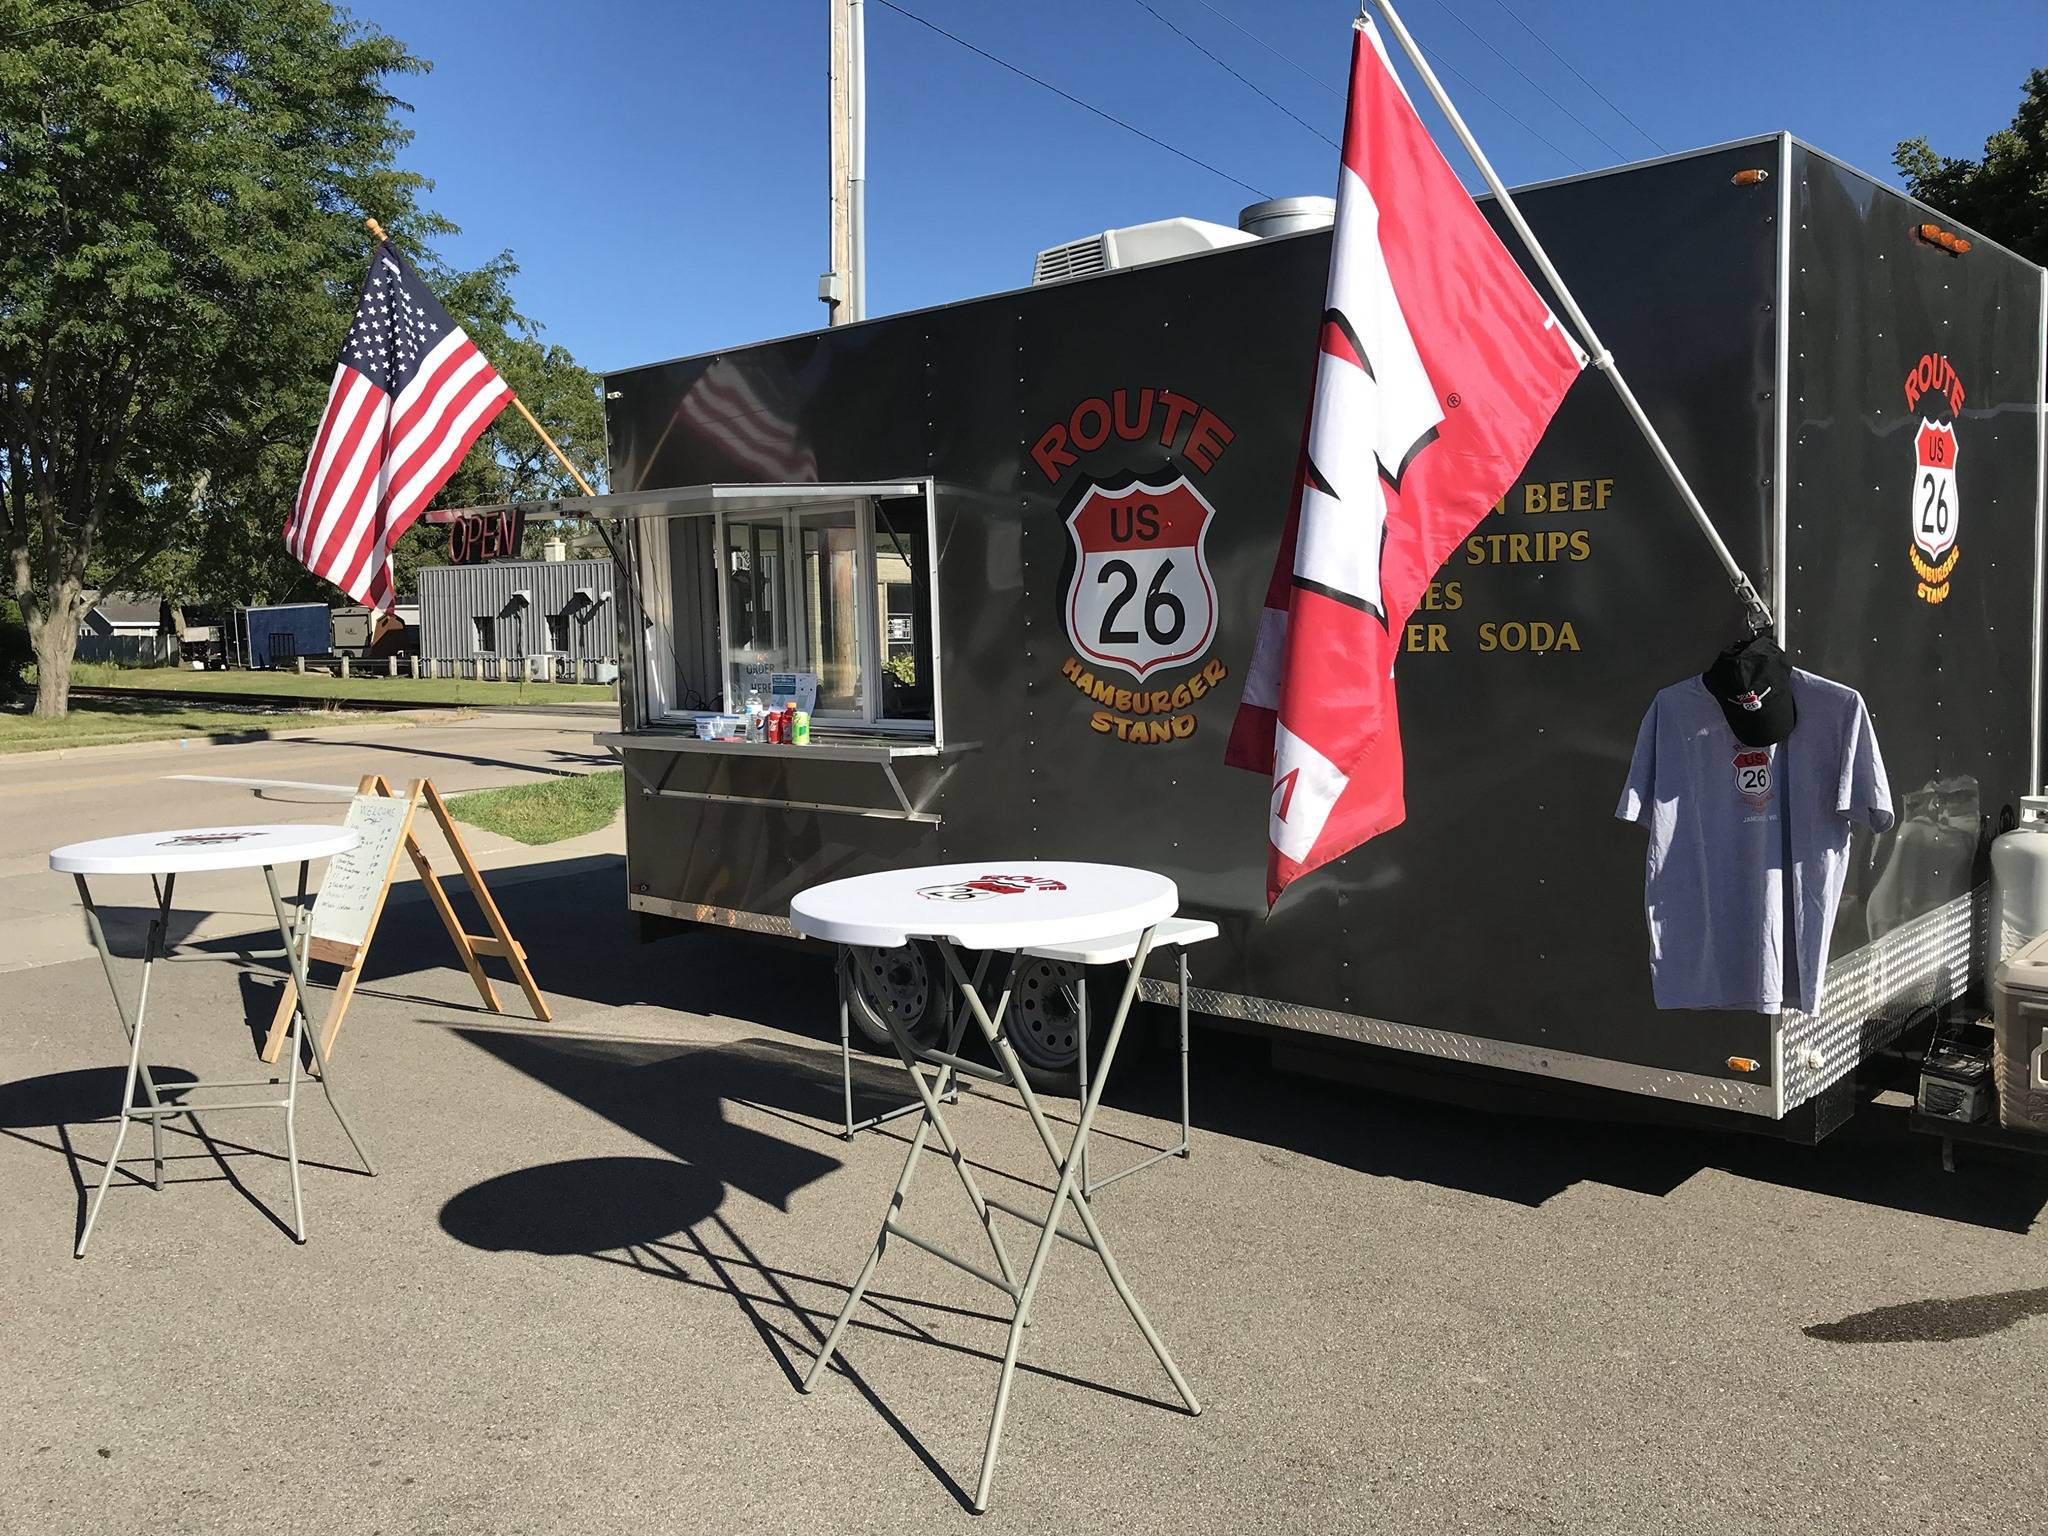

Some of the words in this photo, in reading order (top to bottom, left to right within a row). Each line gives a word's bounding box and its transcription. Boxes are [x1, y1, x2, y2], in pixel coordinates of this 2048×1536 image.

[1904, 352, 1967, 418] ROUTE
[1029, 387, 1236, 485] ROUTE
[1929, 436, 1944, 462] US
[1524, 478, 1614, 514] BEEF
[1921, 473, 1948, 535] 26
[450, 510, 517, 563] OPEN
[1110, 503, 1161, 543] US
[1466, 530, 1592, 565] STRIPS
[1909, 543, 1960, 583] HAMBURGER
[1096, 557, 1186, 646] 26
[1917, 581, 1950, 604] STAND
[1479, 621, 1581, 652] SODA
[746, 664, 775, 675] ORDER
[1061, 657, 1229, 715] HAMBURGER
[1089, 711, 1198, 744] STAND
[1743, 752, 1764, 765] US
[1742, 768, 1767, 789] 26
